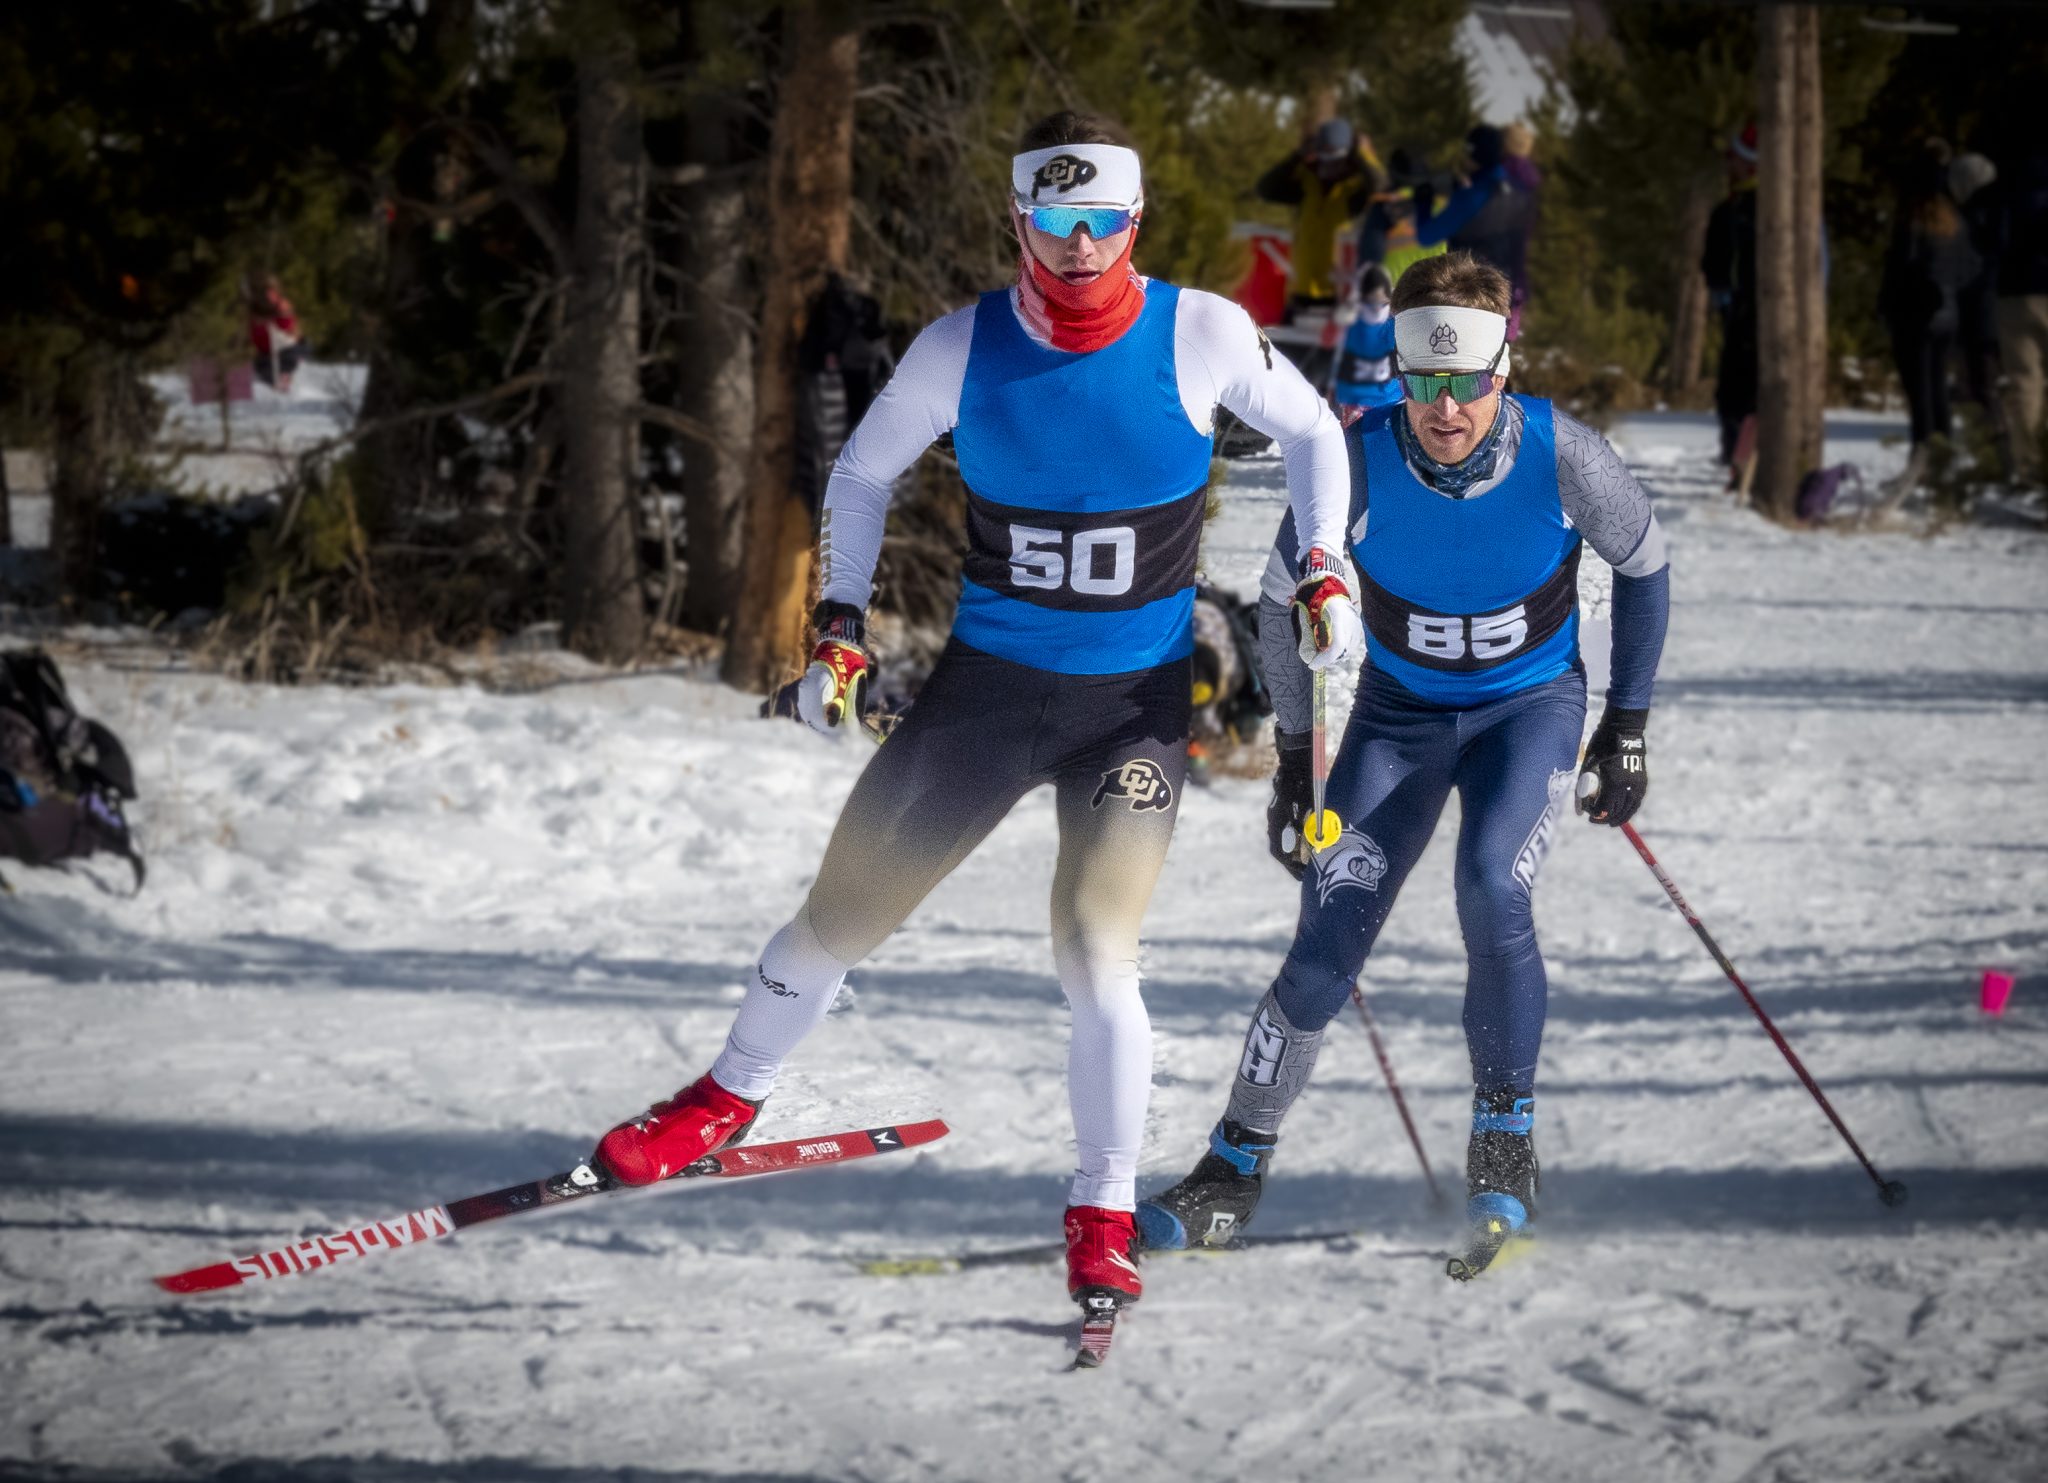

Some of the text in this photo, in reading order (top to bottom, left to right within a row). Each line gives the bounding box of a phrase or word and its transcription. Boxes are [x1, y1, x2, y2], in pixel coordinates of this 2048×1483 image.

[1008, 524, 1136, 595] 50
[1407, 604, 1528, 660] 85
[1119, 763, 1159, 802] CU
[796, 1136, 839, 1157] REDLINE
[231, 1204, 456, 1285] MADSHUS
